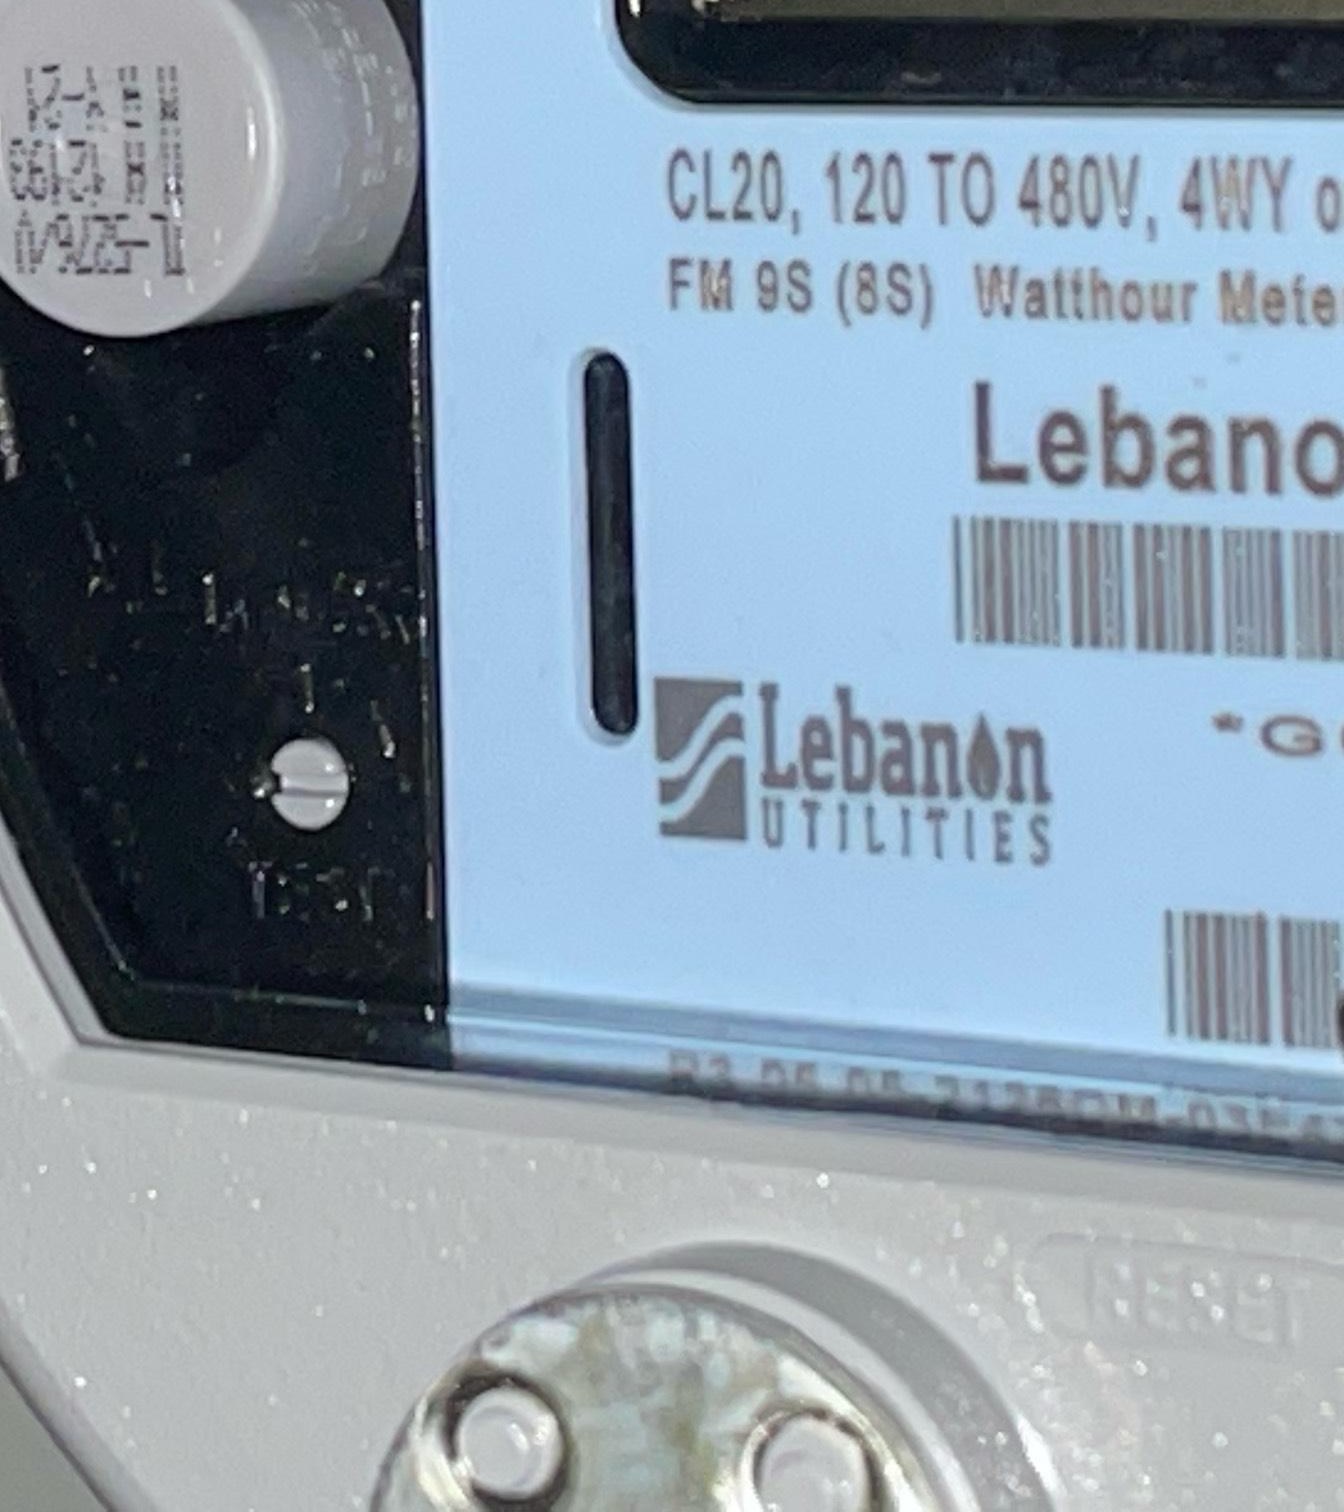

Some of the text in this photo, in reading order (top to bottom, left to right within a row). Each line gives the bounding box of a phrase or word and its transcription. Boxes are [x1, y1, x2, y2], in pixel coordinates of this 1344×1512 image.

[665, 147, 802, 238] CL20,
[824, 149, 908, 227] 120
[926, 150, 997, 229] TO
[1016, 152, 1159, 244] 480V,
[1178, 153, 1296, 236] 4WY
[667, 255, 736, 314] FM
[755, 257, 816, 316] 9S
[835, 259, 936, 332] (8S)
[972, 262, 1200, 326] Watthour
[759, 796, 1055, 868] UTILITIES
